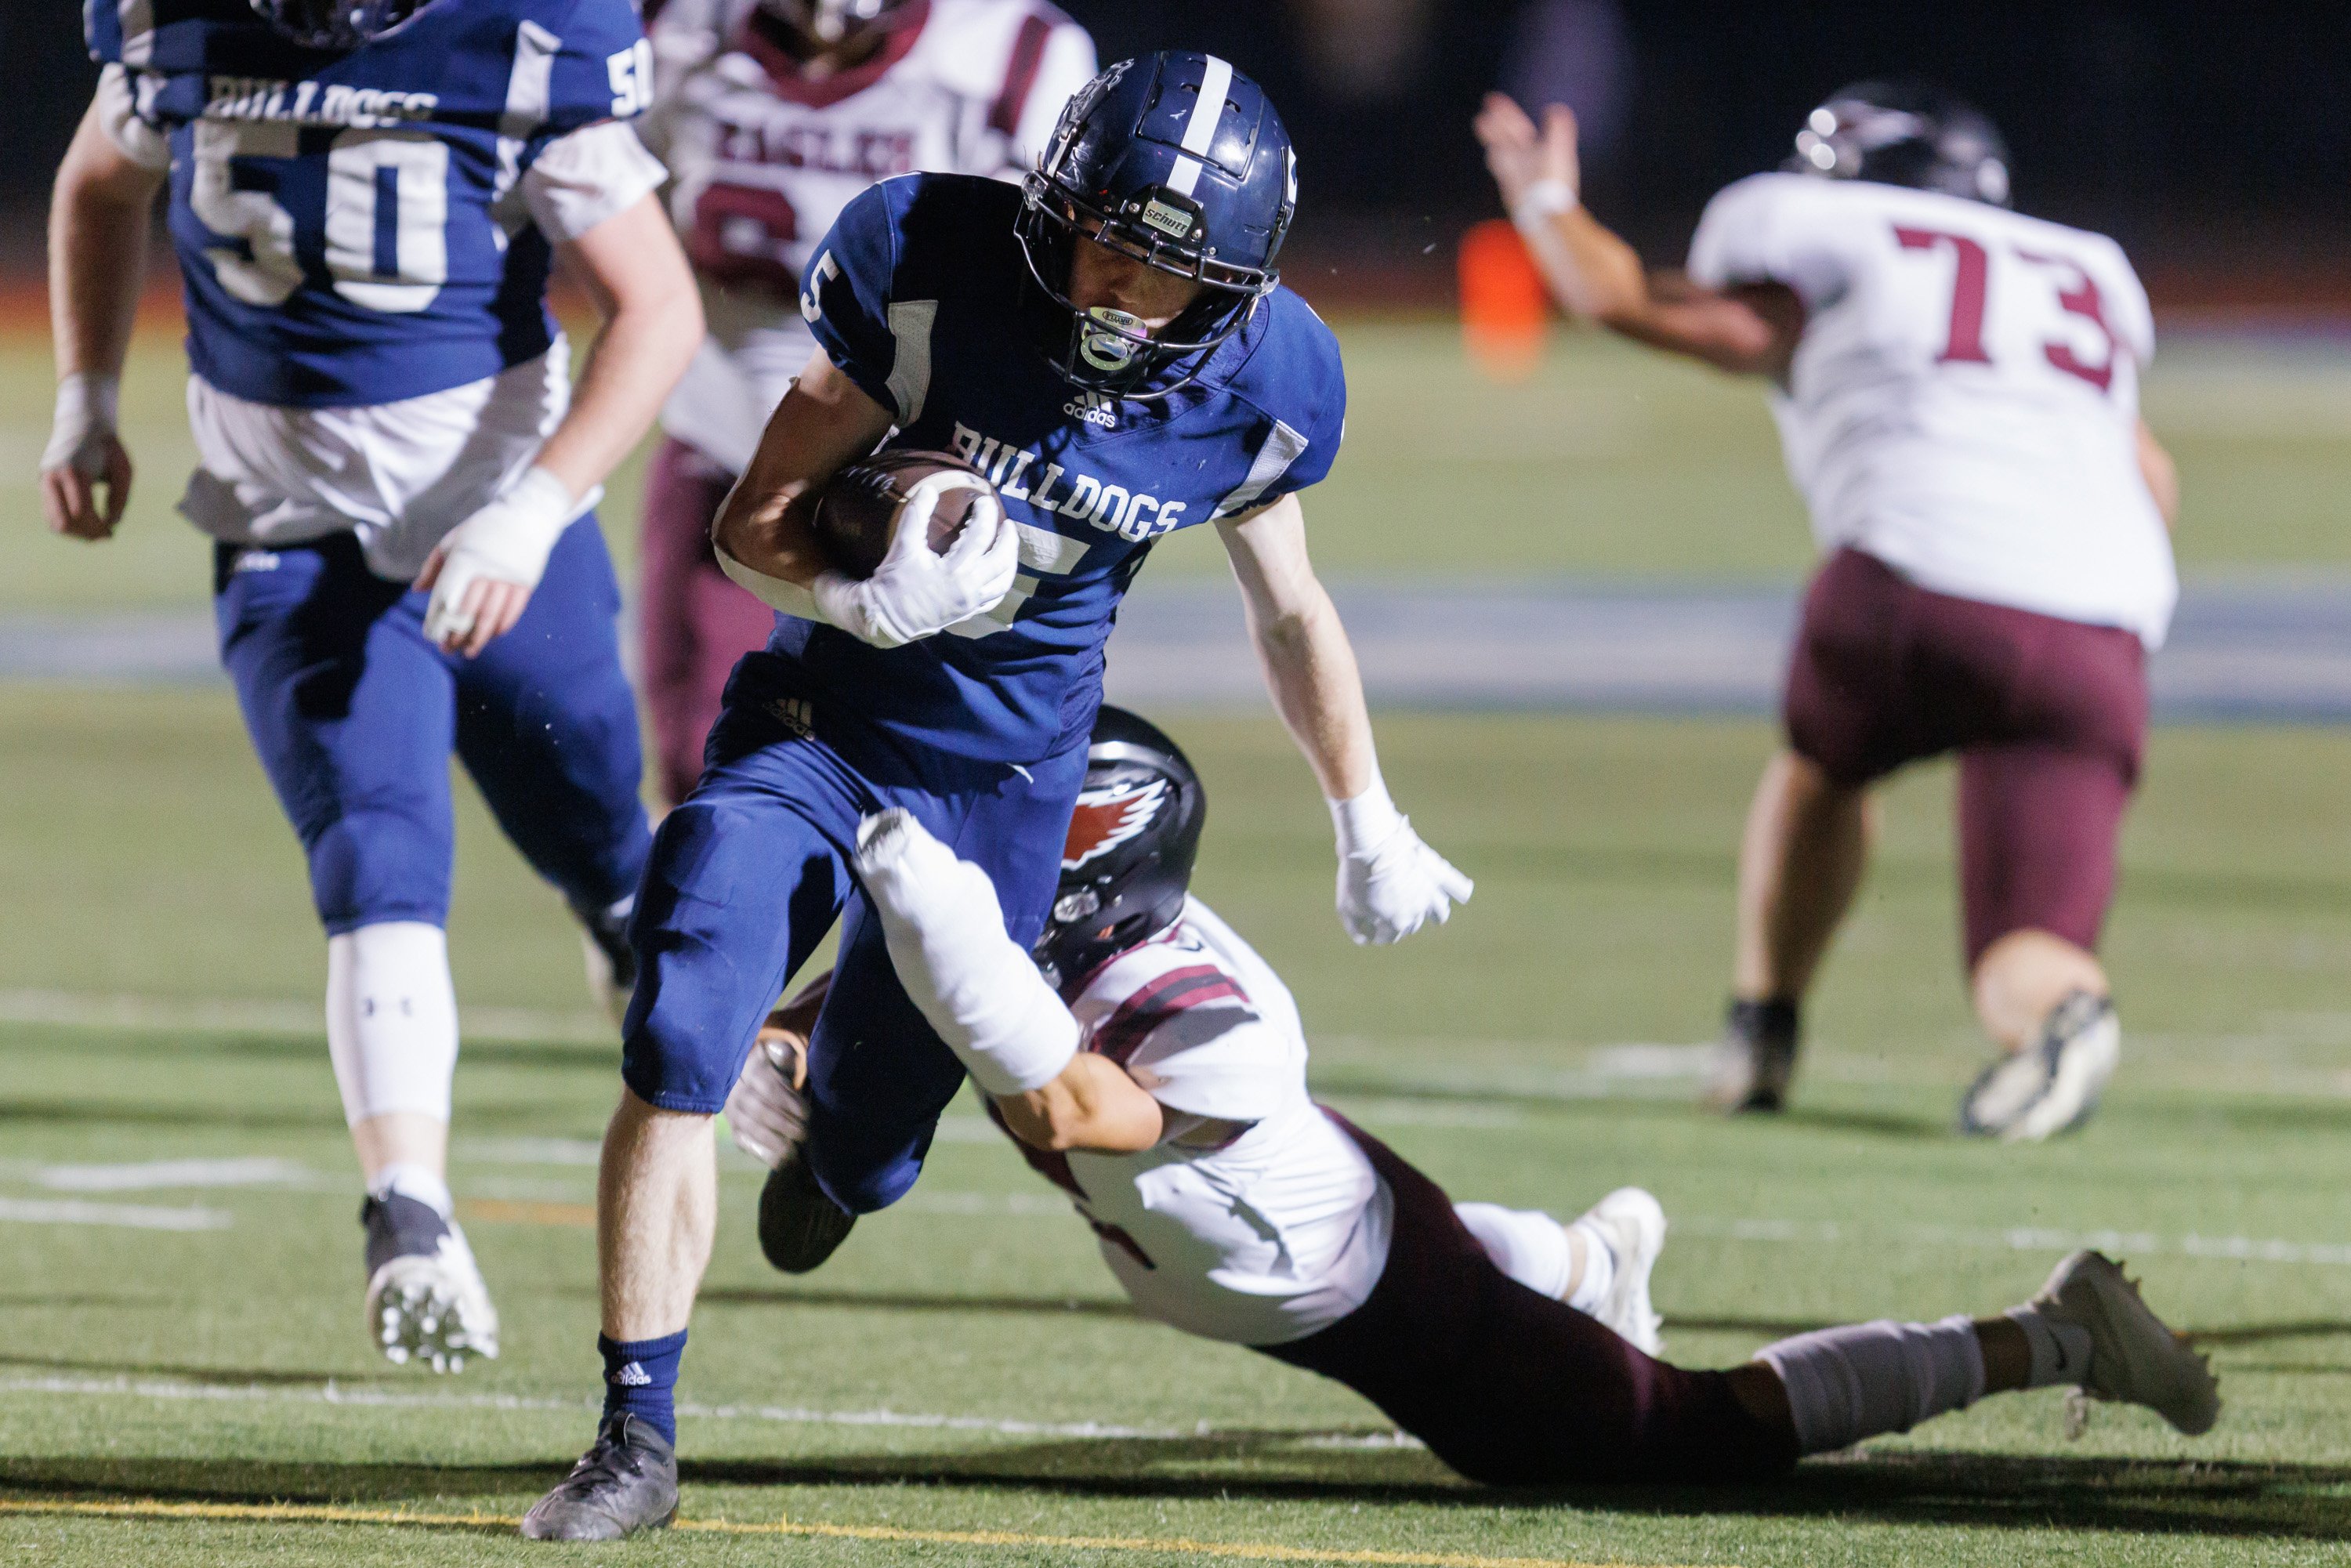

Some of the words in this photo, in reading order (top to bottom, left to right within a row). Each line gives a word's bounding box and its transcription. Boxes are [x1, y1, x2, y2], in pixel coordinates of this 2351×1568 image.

[190, 118, 450, 313] 50
[800, 250, 840, 323] 5
[1893, 226, 2117, 392] 73
[1063, 402, 1116, 429] adidas
[953, 421, 1187, 543] BULLDOGS
[611, 1373, 651, 1386] adidas
